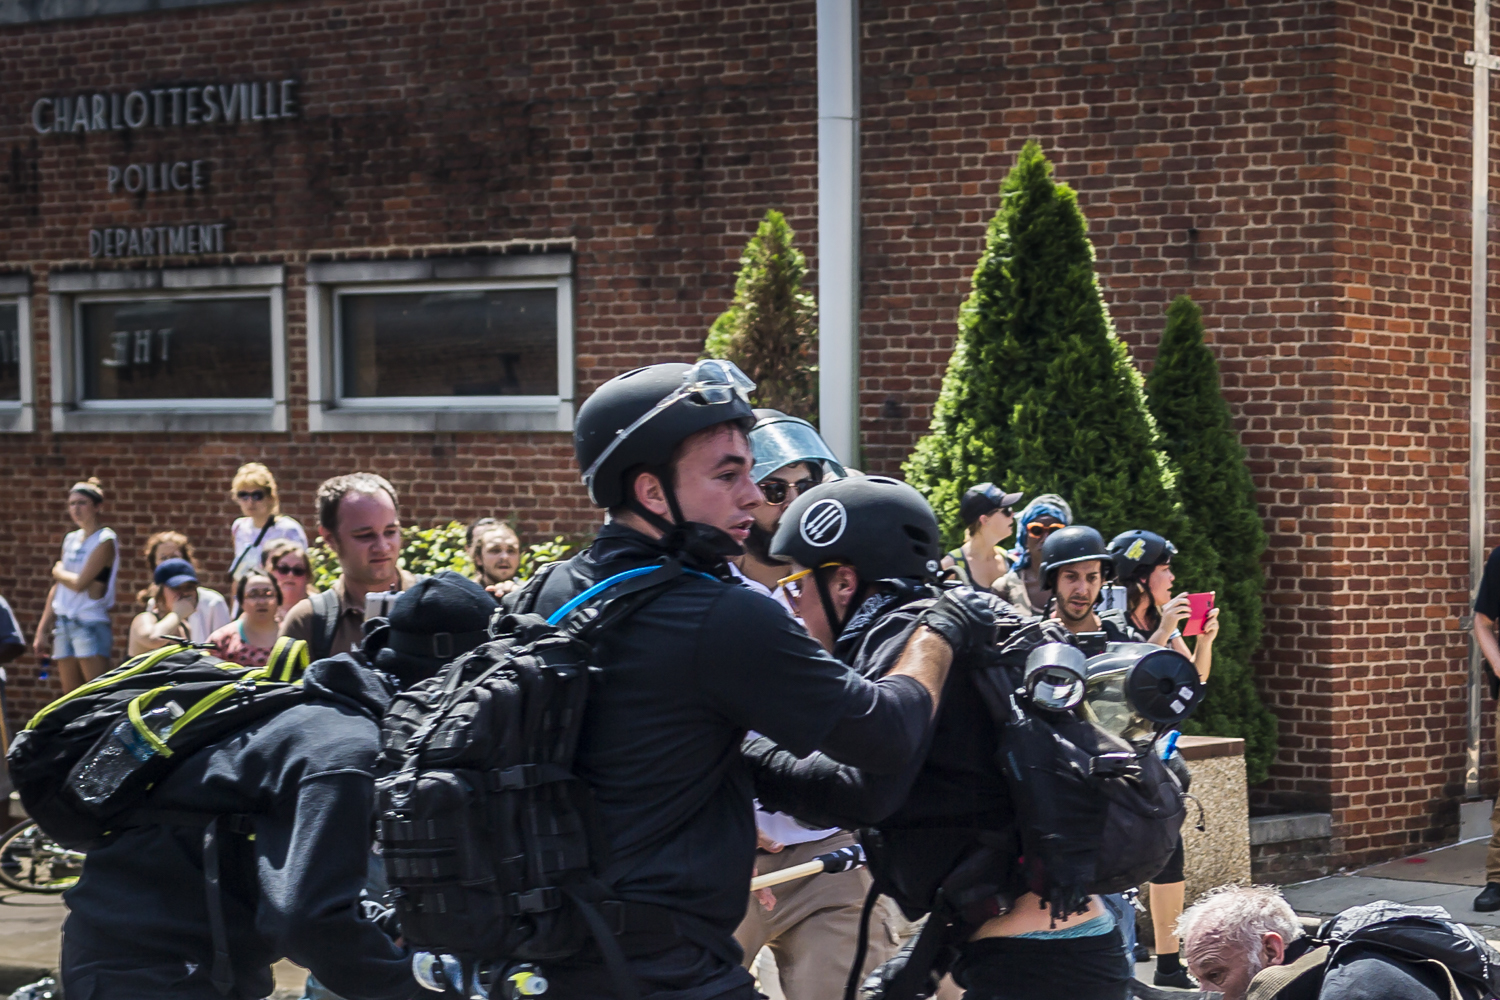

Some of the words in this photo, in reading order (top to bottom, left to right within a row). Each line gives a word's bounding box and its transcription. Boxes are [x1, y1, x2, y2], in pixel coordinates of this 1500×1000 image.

[31, 79, 298, 134] CHARLOTTESVILLE
[107, 159, 205, 194] POLICE
[88, 223, 227, 258] DEPARTMENT
